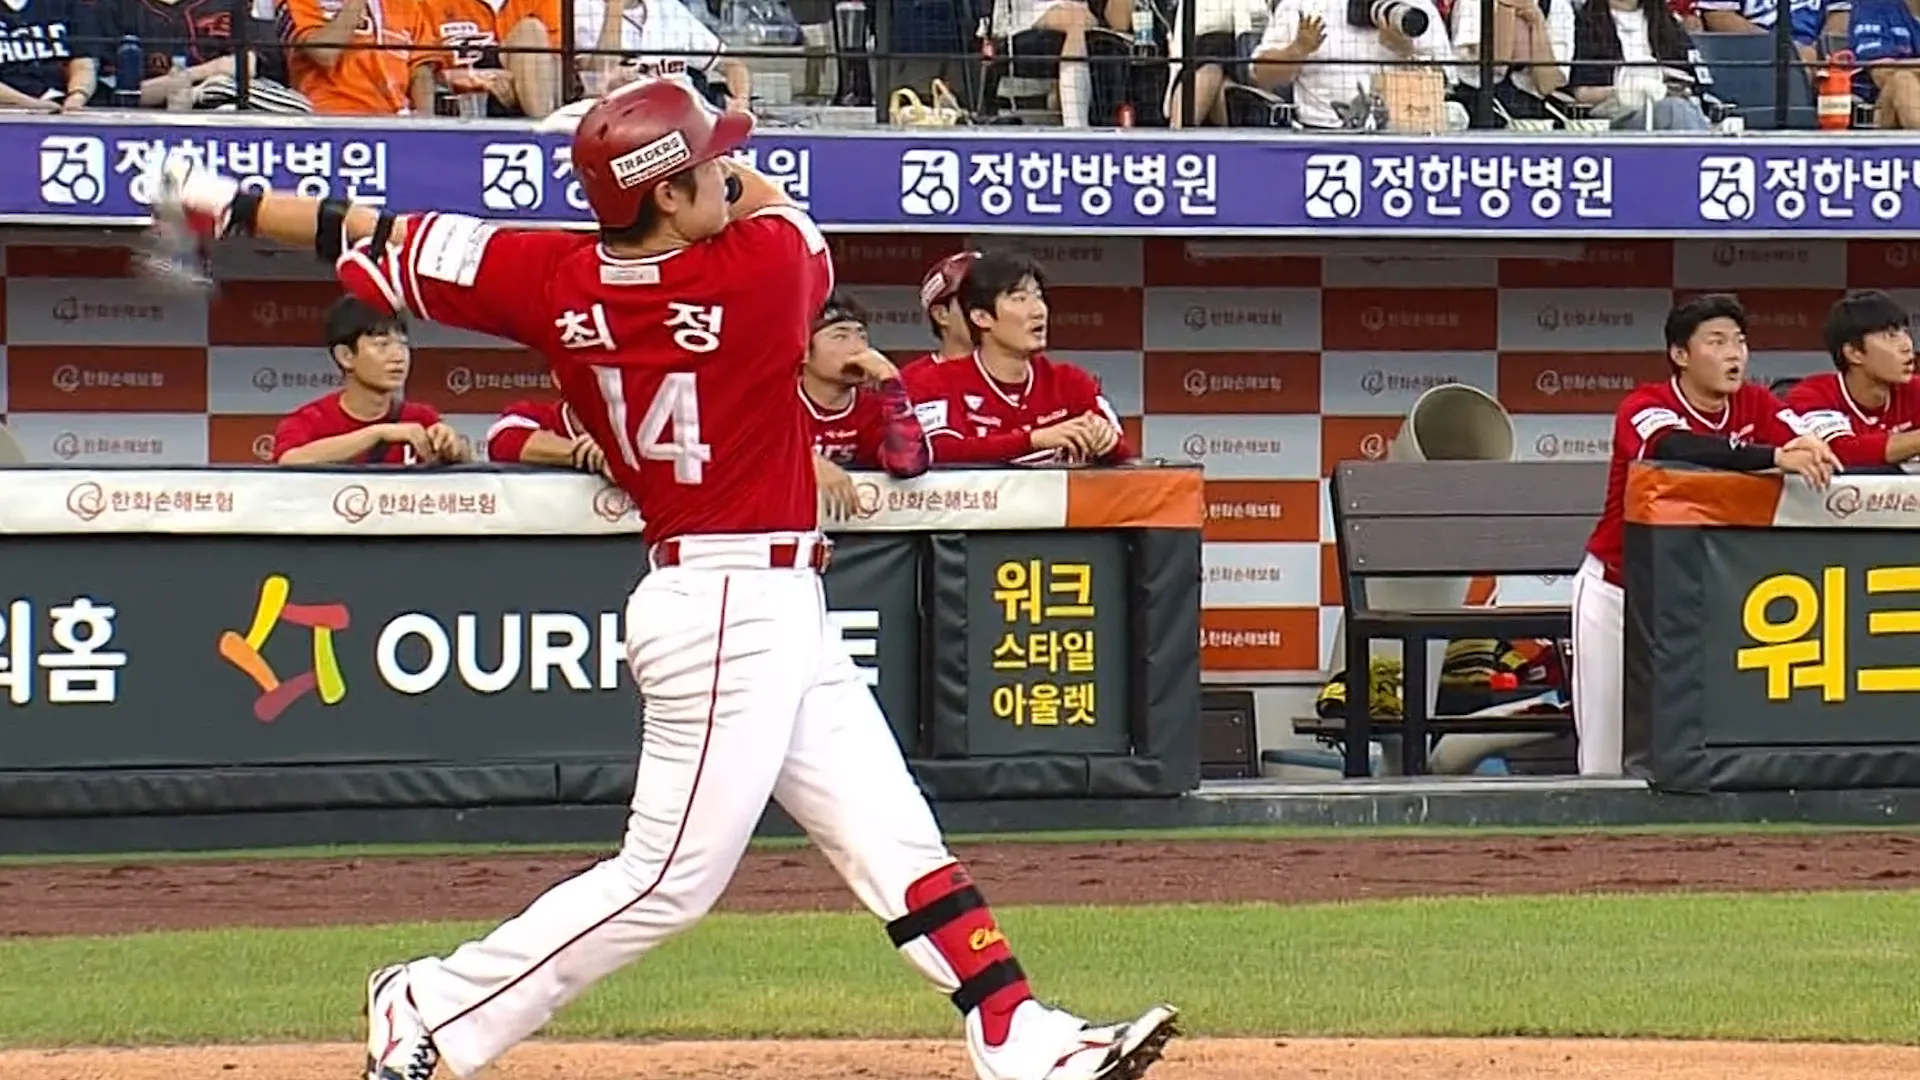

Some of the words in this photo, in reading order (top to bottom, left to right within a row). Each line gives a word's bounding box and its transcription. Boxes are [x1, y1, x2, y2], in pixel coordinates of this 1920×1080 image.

[615, 136, 681, 174] TRADERS
[969, 152, 1217, 216] 정한방병원
[1370, 155, 1614, 218] 정한방병원
[1763, 156, 1920, 219] 정한방
[555, 303, 617, 351] 최
[663, 302, 724, 353] 정
[590, 364, 711, 485] 14
[110, 490, 234, 514] 한화손해보험
[378, 491, 497, 515] 한화손해보험
[887, 488, 998, 513] 한화손해보험
[993, 557, 1096, 625] 워크
[992, 630, 1096, 674] 스타일
[992, 684, 1097, 727] 아울렛
